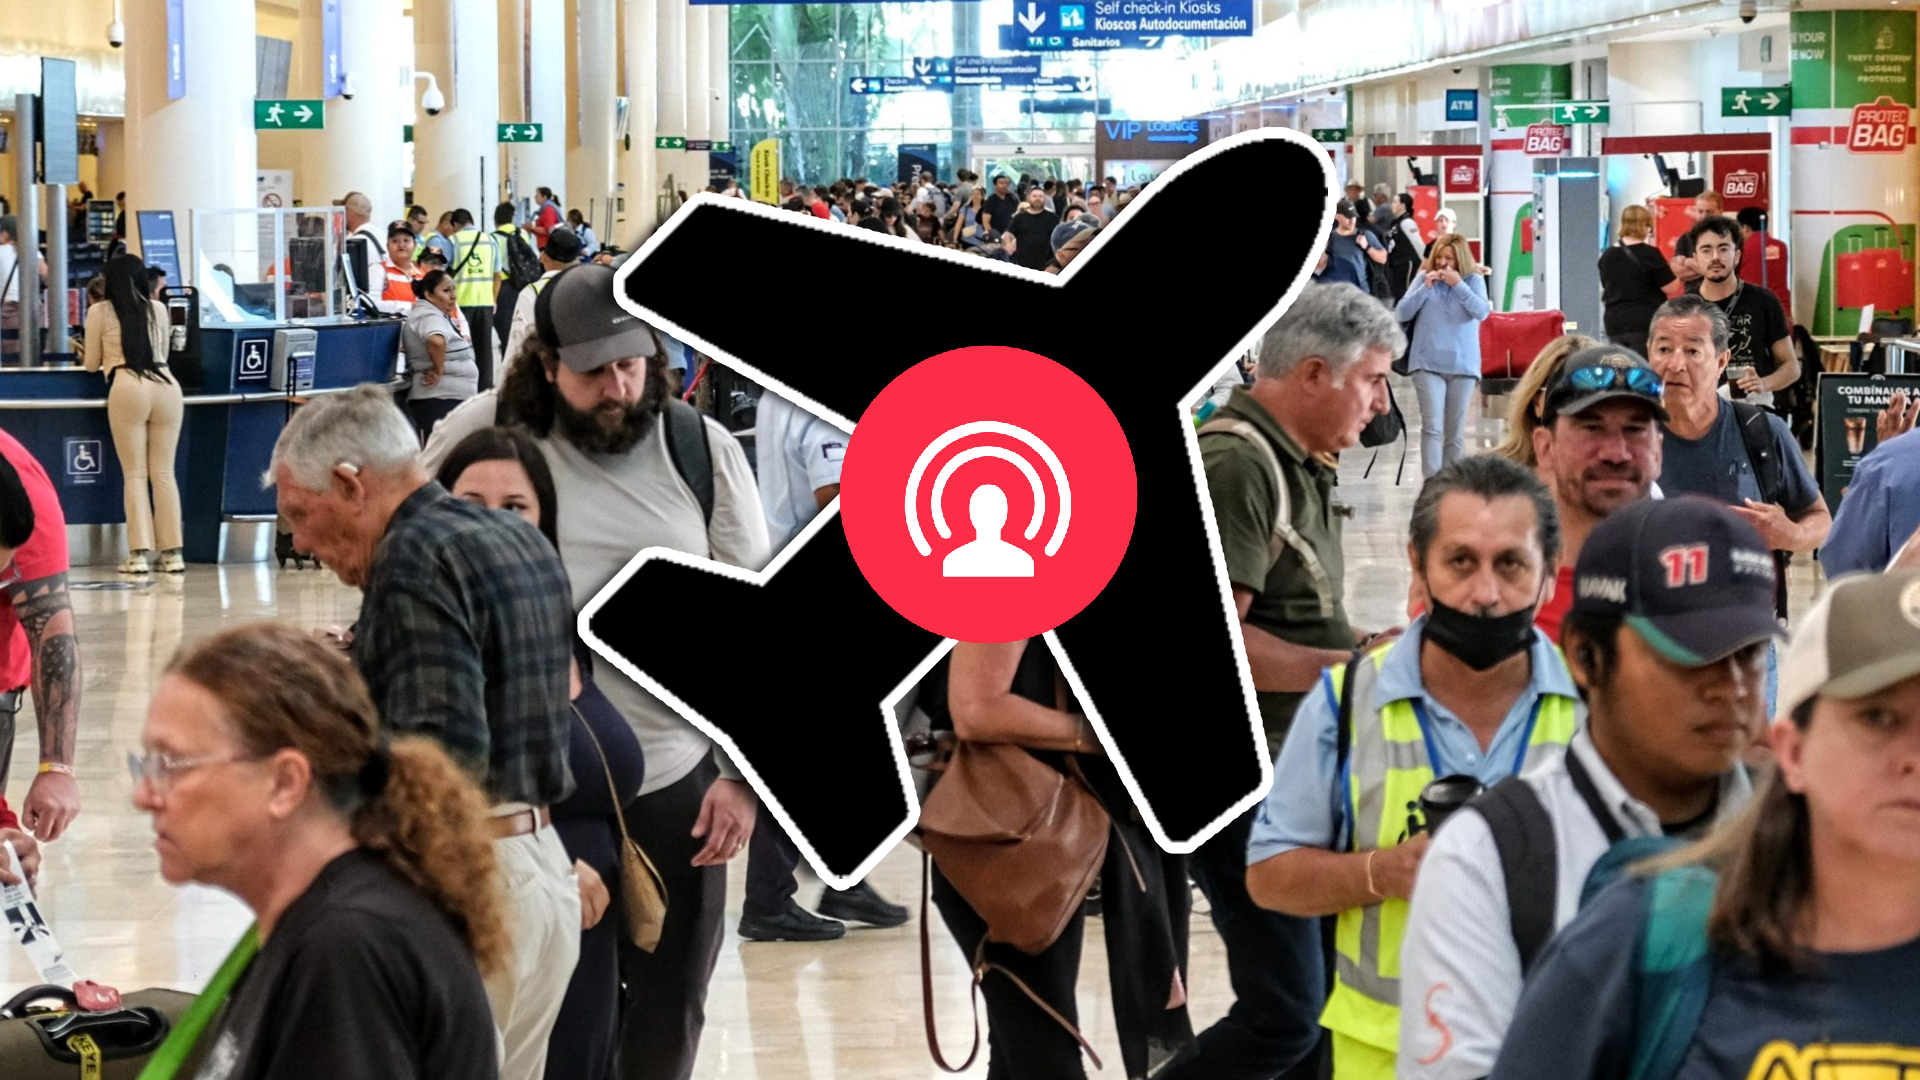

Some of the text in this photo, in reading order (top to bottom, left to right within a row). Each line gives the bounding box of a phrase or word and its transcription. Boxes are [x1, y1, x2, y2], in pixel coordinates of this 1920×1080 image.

[1096, 1, 1221, 14] Self check-in Kiosks
[1095, 16, 1247, 31] Kioscos Autodocumentación
[1072, 37, 1121, 47] Sanitarios
[1797, 32, 1826, 43] YOUR
[1799, 50, 1825, 59] NOW
[1848, 54, 1873, 62] THEFT
[955, 66, 1038, 74] Kioscos de documentación
[1864, 65, 1902, 73] LUGGAGE
[1858, 75, 1907, 83] PROTECTION
[1450, 100, 1474, 111] ATM
[1857, 109, 1907, 123] PROTEC
[1104, 121, 1199, 140] VIP LOUNGE
[1529, 127, 1563, 136] PROTEC
[1853, 124, 1906, 147] BAG
[1527, 137, 1562, 152] BAG
[1452, 174, 1473, 182] BAG
[1726, 182, 1755, 195] BAG
[1837, 385, 1920, 396] COMBÍNALOS A
[1847, 396, 1862, 405] TU
[1659, 542, 1710, 589] 11
